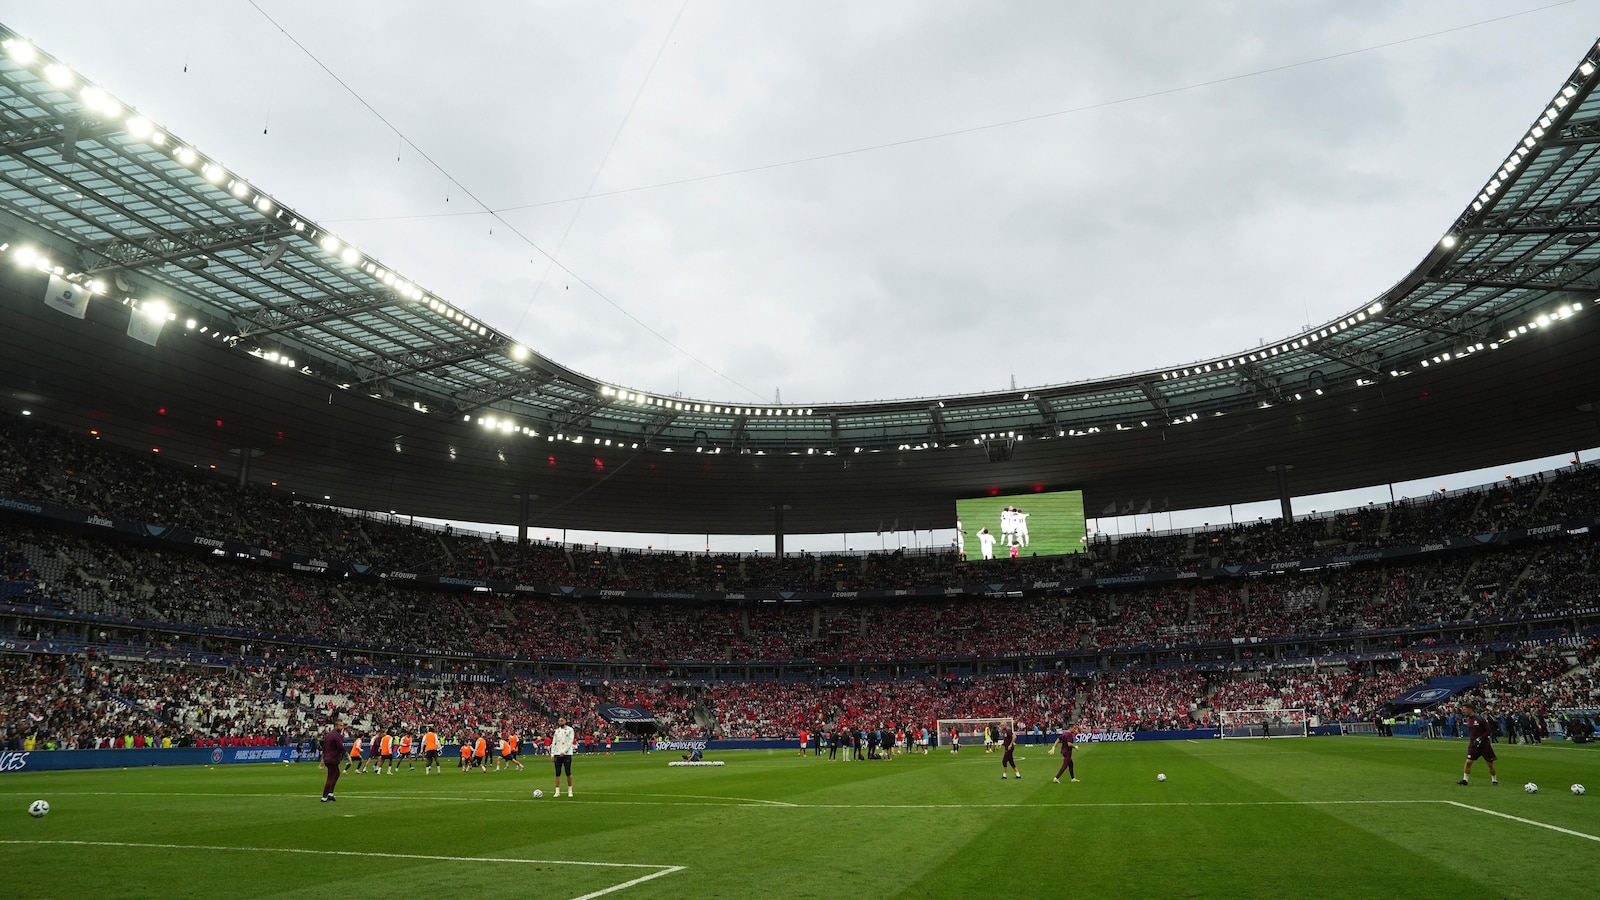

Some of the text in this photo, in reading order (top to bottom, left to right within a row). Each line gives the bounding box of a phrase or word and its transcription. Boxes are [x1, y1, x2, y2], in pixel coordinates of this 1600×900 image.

[93, 514, 113, 527] Parisien
[1075, 733, 1092, 743] STOP
[1099, 732, 1135, 742] VIOLENCES
[656, 741, 671, 750] STOP
[677, 741, 706, 750] VIOLENCES
